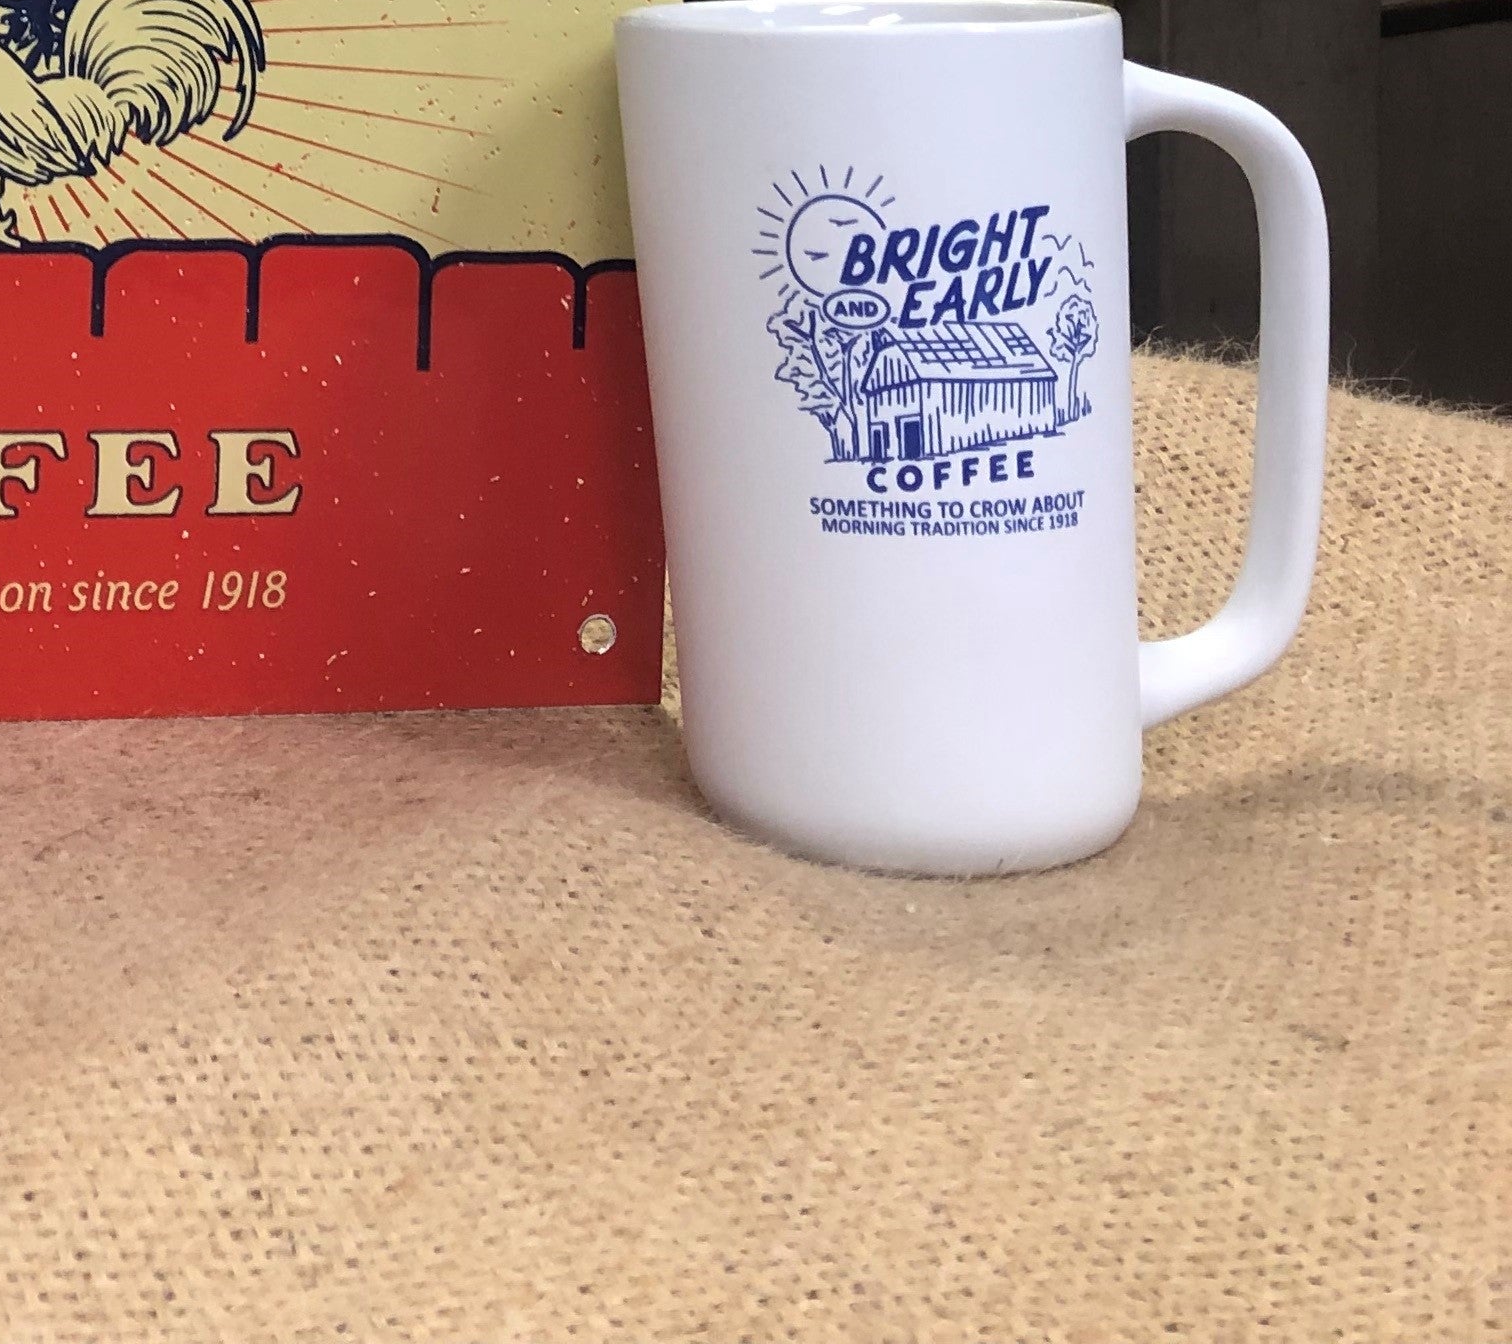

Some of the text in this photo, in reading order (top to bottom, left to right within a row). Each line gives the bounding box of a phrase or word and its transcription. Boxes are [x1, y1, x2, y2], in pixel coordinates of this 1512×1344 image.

[839, 205, 1050, 286] BRIGHT
[833, 256, 1053, 330] AND EARLY
[866, 450, 1036, 493] COFFEE
[809, 489, 1085, 520] SOMETHING TO CROW ABOUT
[821, 511, 1079, 537] MORNING TRADITION SINCE 1918
[71, 570, 180, 614] since
[201, 569, 289, 612] 1918
